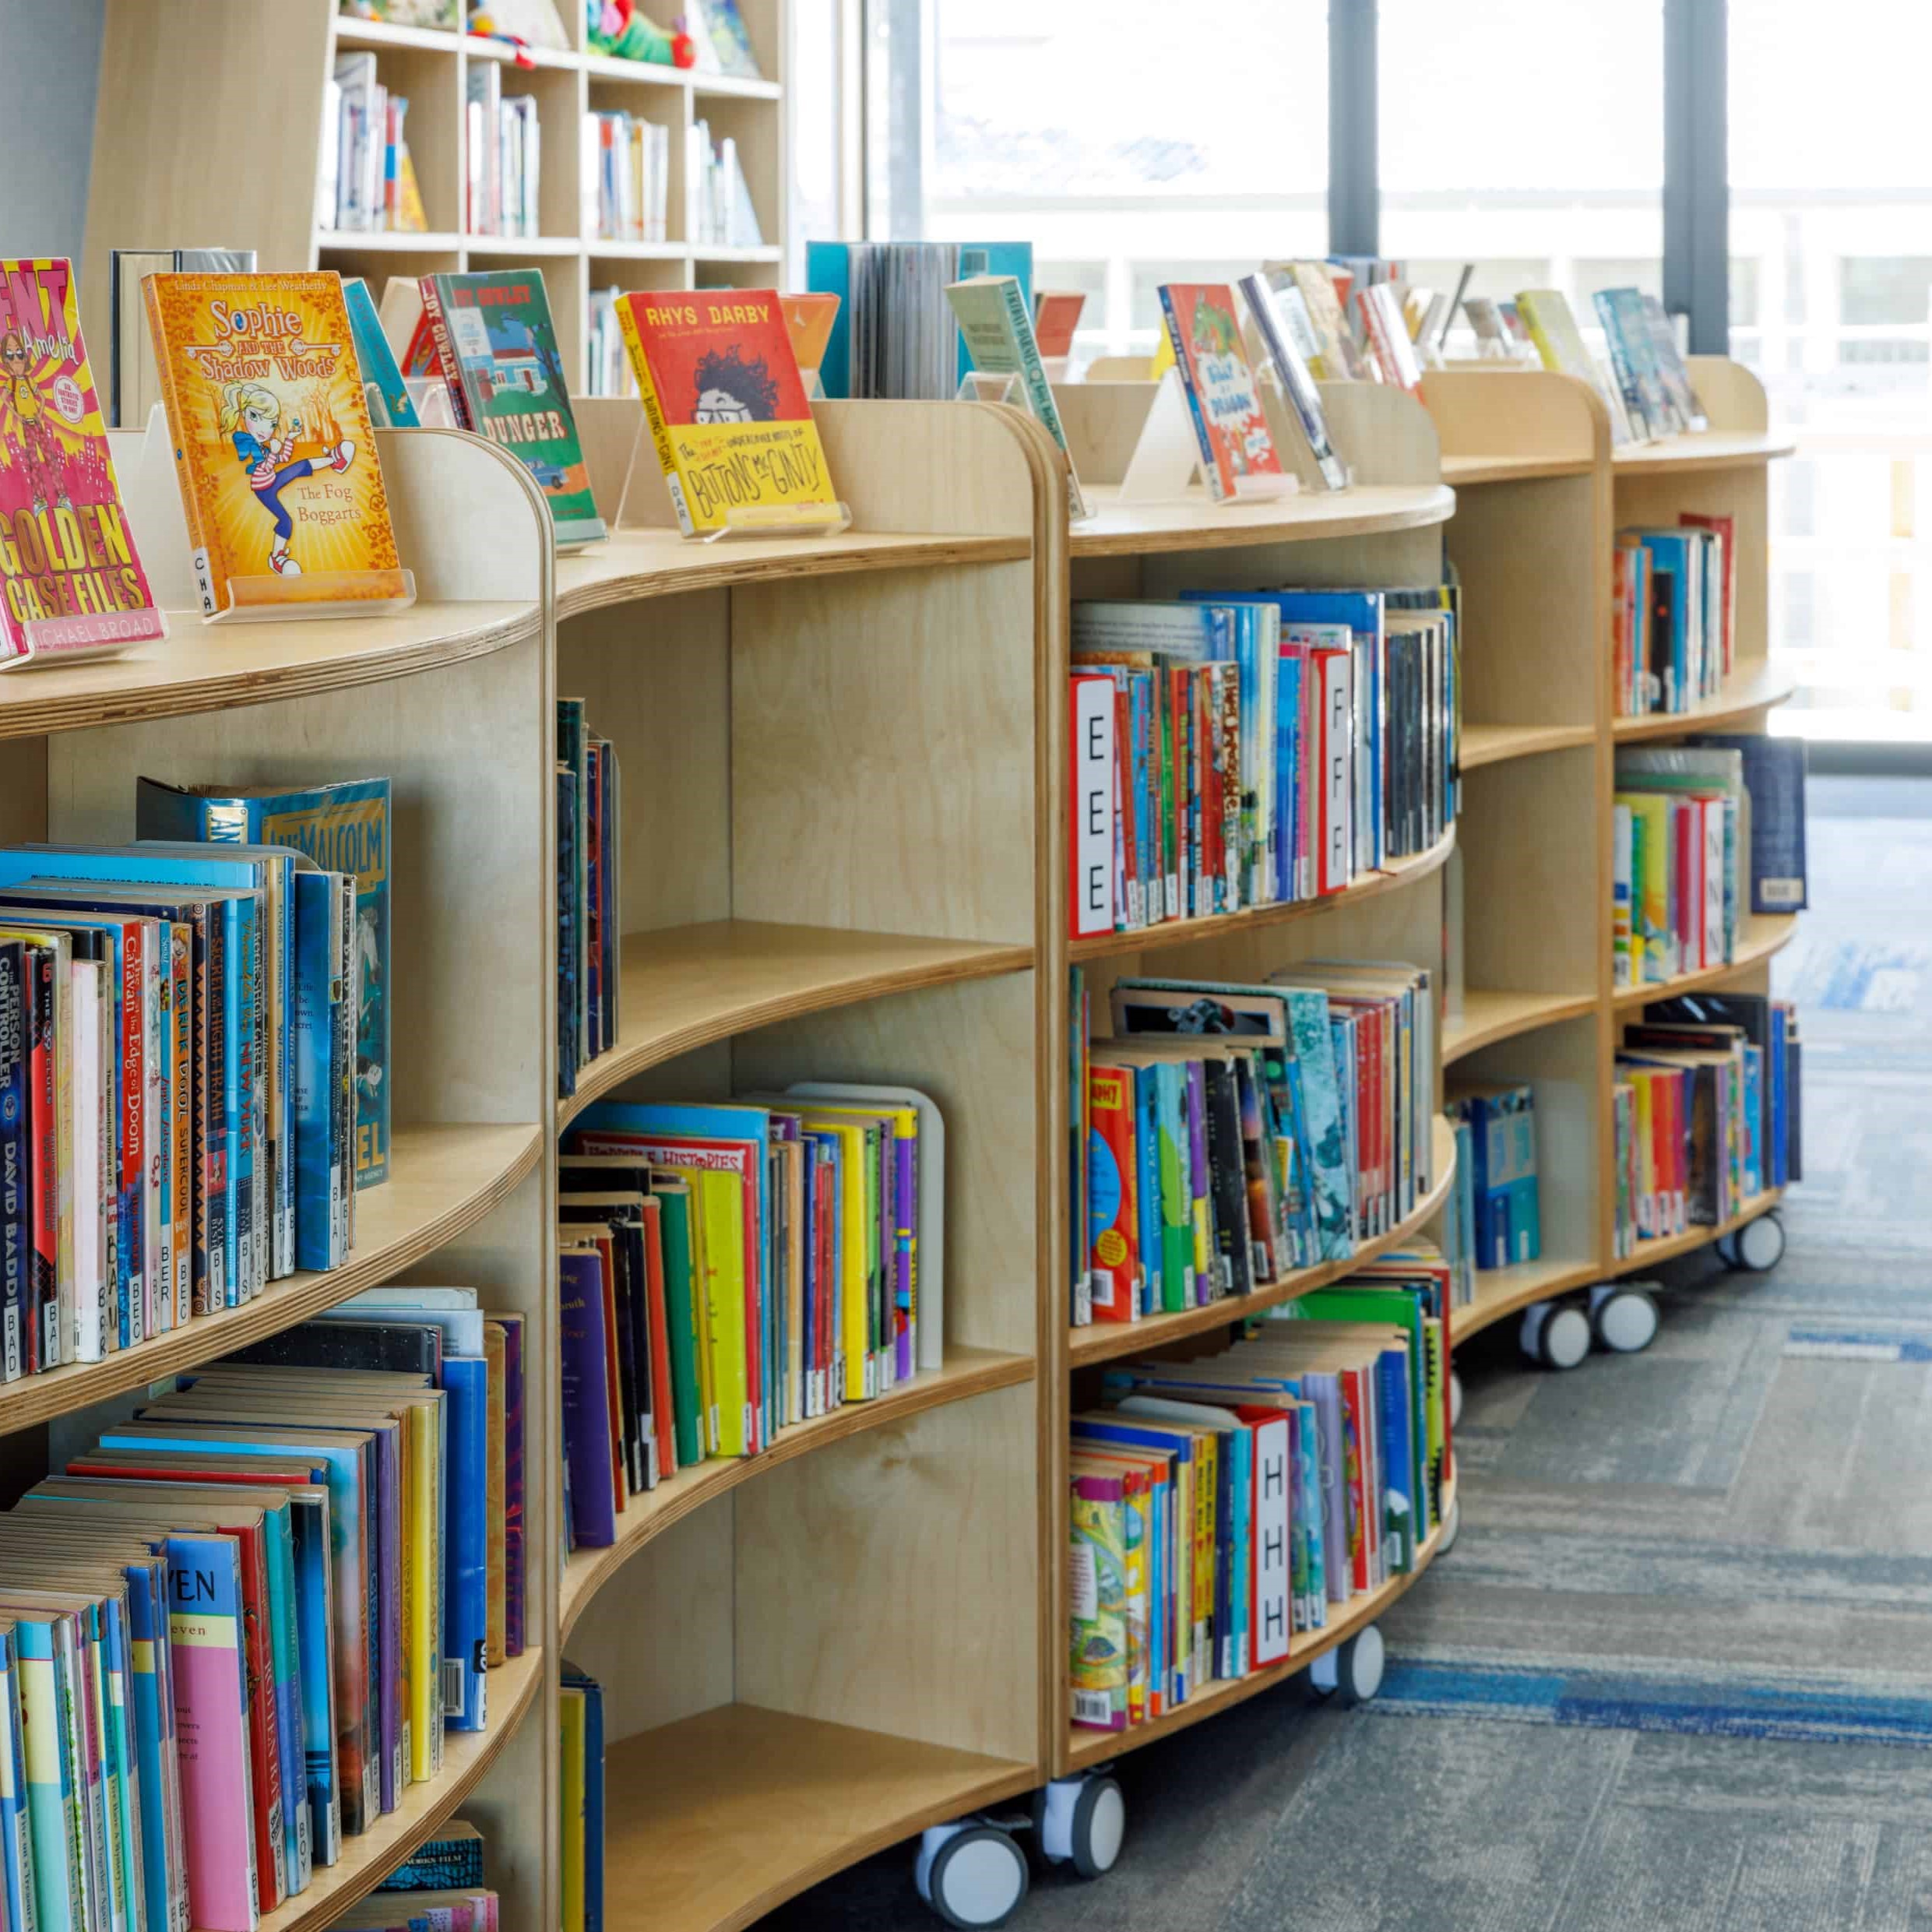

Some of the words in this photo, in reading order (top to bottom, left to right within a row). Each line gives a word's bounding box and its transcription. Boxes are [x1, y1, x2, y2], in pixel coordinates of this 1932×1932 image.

[175, 280, 201, 290] Linda
[203, 281, 247, 293] Chapman
[260, 281, 277, 290] Lee
[280, 280, 328, 293] Weatherly
[210, 300, 304, 340] Sophie
[421, 283, 436, 319] JOY
[432, 324, 459, 382] COWLEY
[646, 306, 699, 327] RHYS
[710, 304, 769, 325] DARBY
[23, 326, 79, 366] Amelia
[201, 354, 270, 382] Shadow
[276, 355, 336, 381] Woods
[237, 341, 260, 356] AND
[263, 340, 286, 354] THE
[484, 411, 567, 443] DUNGER
[678, 442, 696, 461] The
[297, 486, 322, 501] The
[323, 484, 354, 502] Fog
[687, 452, 761, 519] BUTTONS
[297, 506, 362, 525] Boggarts
[0, 503, 133, 578] GOLDEN
[5, 573, 74, 624] CASE
[72, 567, 146, 616] FILES
[194, 557, 213, 611] CHA
[100, 617, 154, 643] BROAD
[1334, 688, 1343, 730] F
[1089, 716, 1105, 761] E
[1334, 757, 1343, 799] F
[1089, 791, 1105, 836] E
[299, 819, 383, 875] MALCOLM
[1334, 825, 1343, 868] F
[1089, 865, 1105, 910] E
[41, 962, 53, 983] 6
[125, 936, 138, 1013] Caravan
[135, 954, 143, 985] The
[210, 936, 224, 991] SECRET
[254, 932, 263, 1022] BOOKSHOP
[0, 956, 11, 1089] CONTROLLER
[9, 985, 20, 1064] PERSON
[41, 1020, 52, 1050] 39
[177, 979, 188, 1054] DEREK
[125, 1032, 141, 1079] Edge
[241, 1042, 253, 1092] NEW
[254, 1027, 263, 1065] GIRL
[178, 1060, 189, 1124] DOOL
[127, 1093, 140, 1156] Doom
[239, 1100, 253, 1158] YORK
[357, 1121, 385, 1171] EL
[4, 1141, 17, 1216] DAVID
[178, 1126, 190, 1217] SUPERCOOL
[663, 1150, 740, 1171] HISTORIES
[160, 1245, 170, 1302] BER
[213, 1252, 222, 1307] BIS
[132, 1282, 141, 1340] BEC
[7, 1314, 16, 1372] BAD
[1264, 1454, 1283, 1500] H
[1264, 1525, 1283, 1571] H
[1264, 1595, 1283, 1641] H
[263, 1662, 277, 1756] ROTTEN
[299, 1821, 308, 1872] BOY
